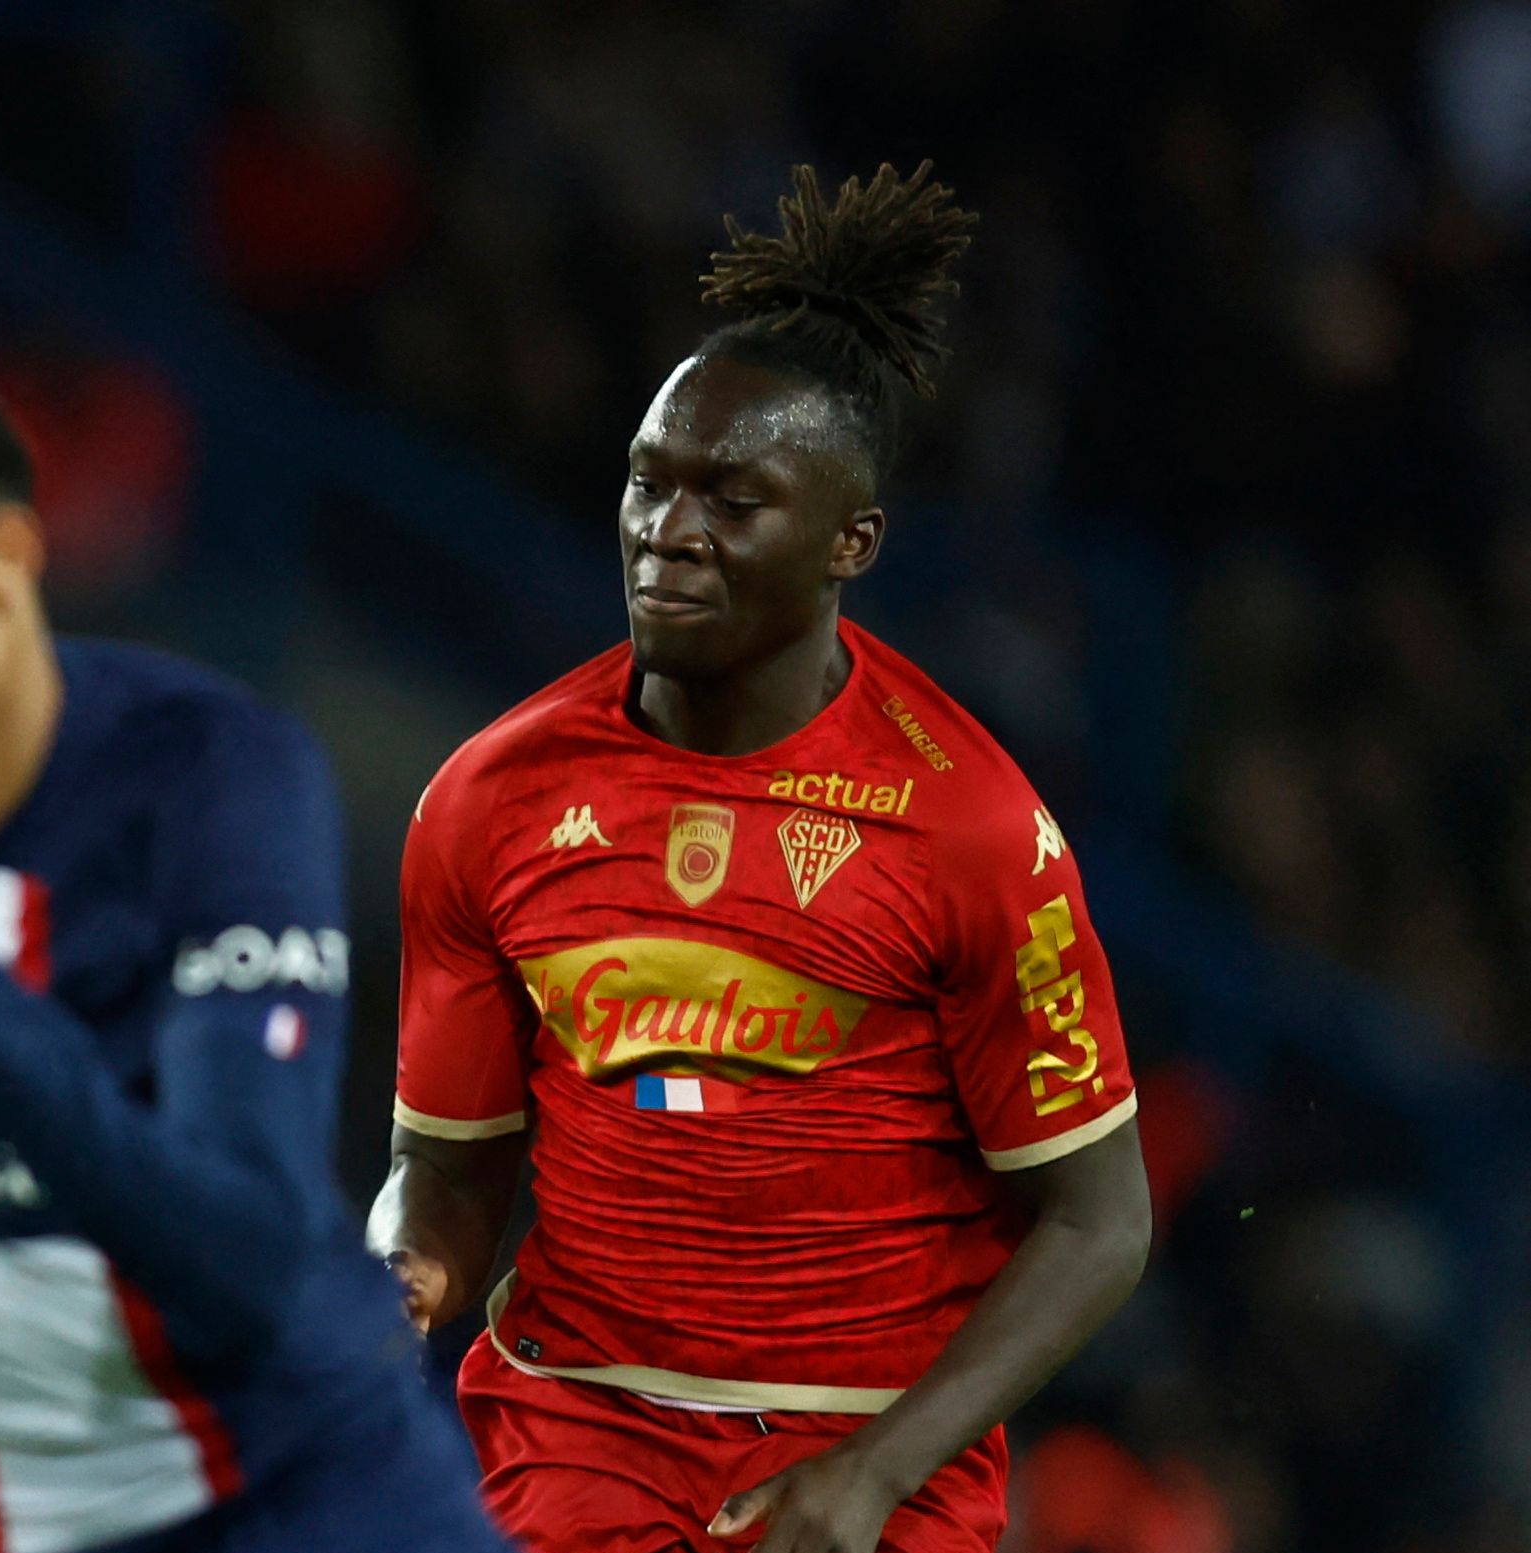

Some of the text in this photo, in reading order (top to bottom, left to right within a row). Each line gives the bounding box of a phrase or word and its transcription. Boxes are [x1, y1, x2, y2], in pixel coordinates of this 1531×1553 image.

[768, 769, 914, 816] actual
[791, 820, 846, 853] SCO
[571, 957, 841, 1066] Gaulois
